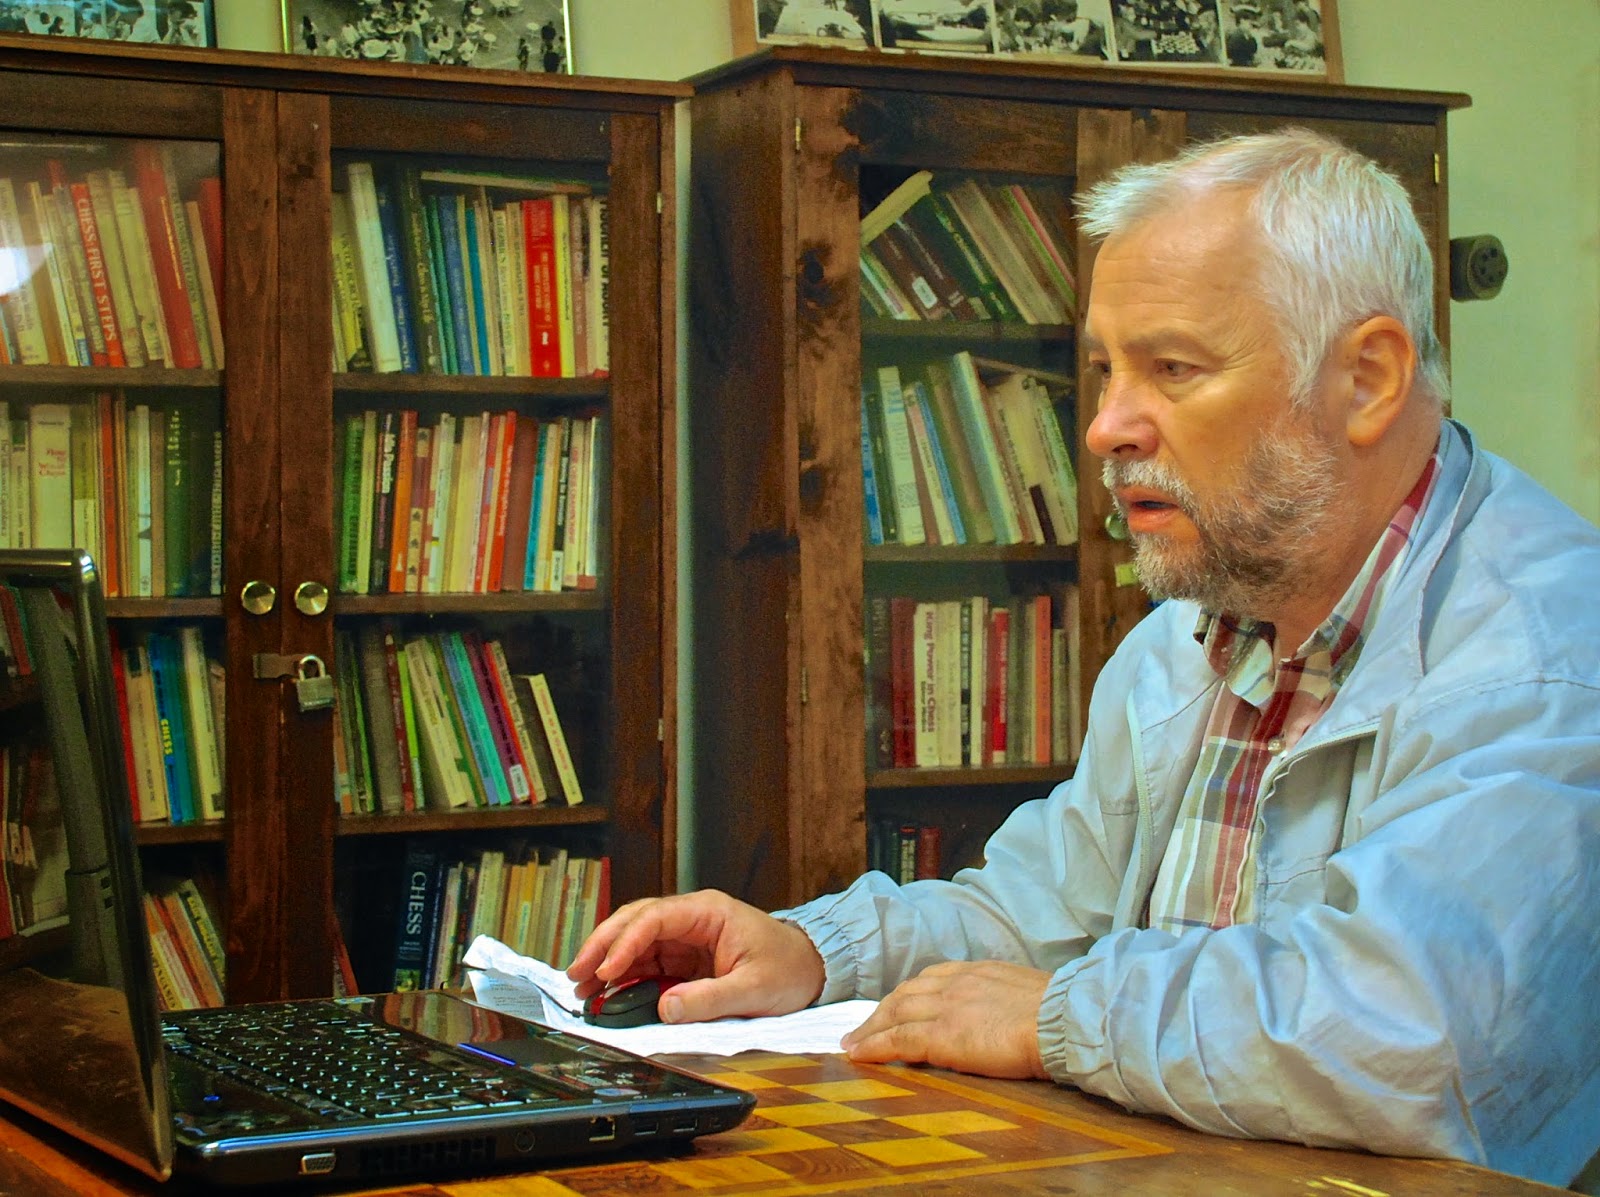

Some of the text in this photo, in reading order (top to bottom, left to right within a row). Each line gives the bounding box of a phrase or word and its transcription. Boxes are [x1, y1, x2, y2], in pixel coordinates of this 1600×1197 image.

[86, 249, 107, 290] FIRST
[97, 295, 117, 342] STEPS
[923, 612, 935, 640] King
[926, 642, 936, 681] Power
[926, 697, 937, 732] Chess
[161, 719, 174, 755] CHESS
[405, 871, 428, 935] CHESS
